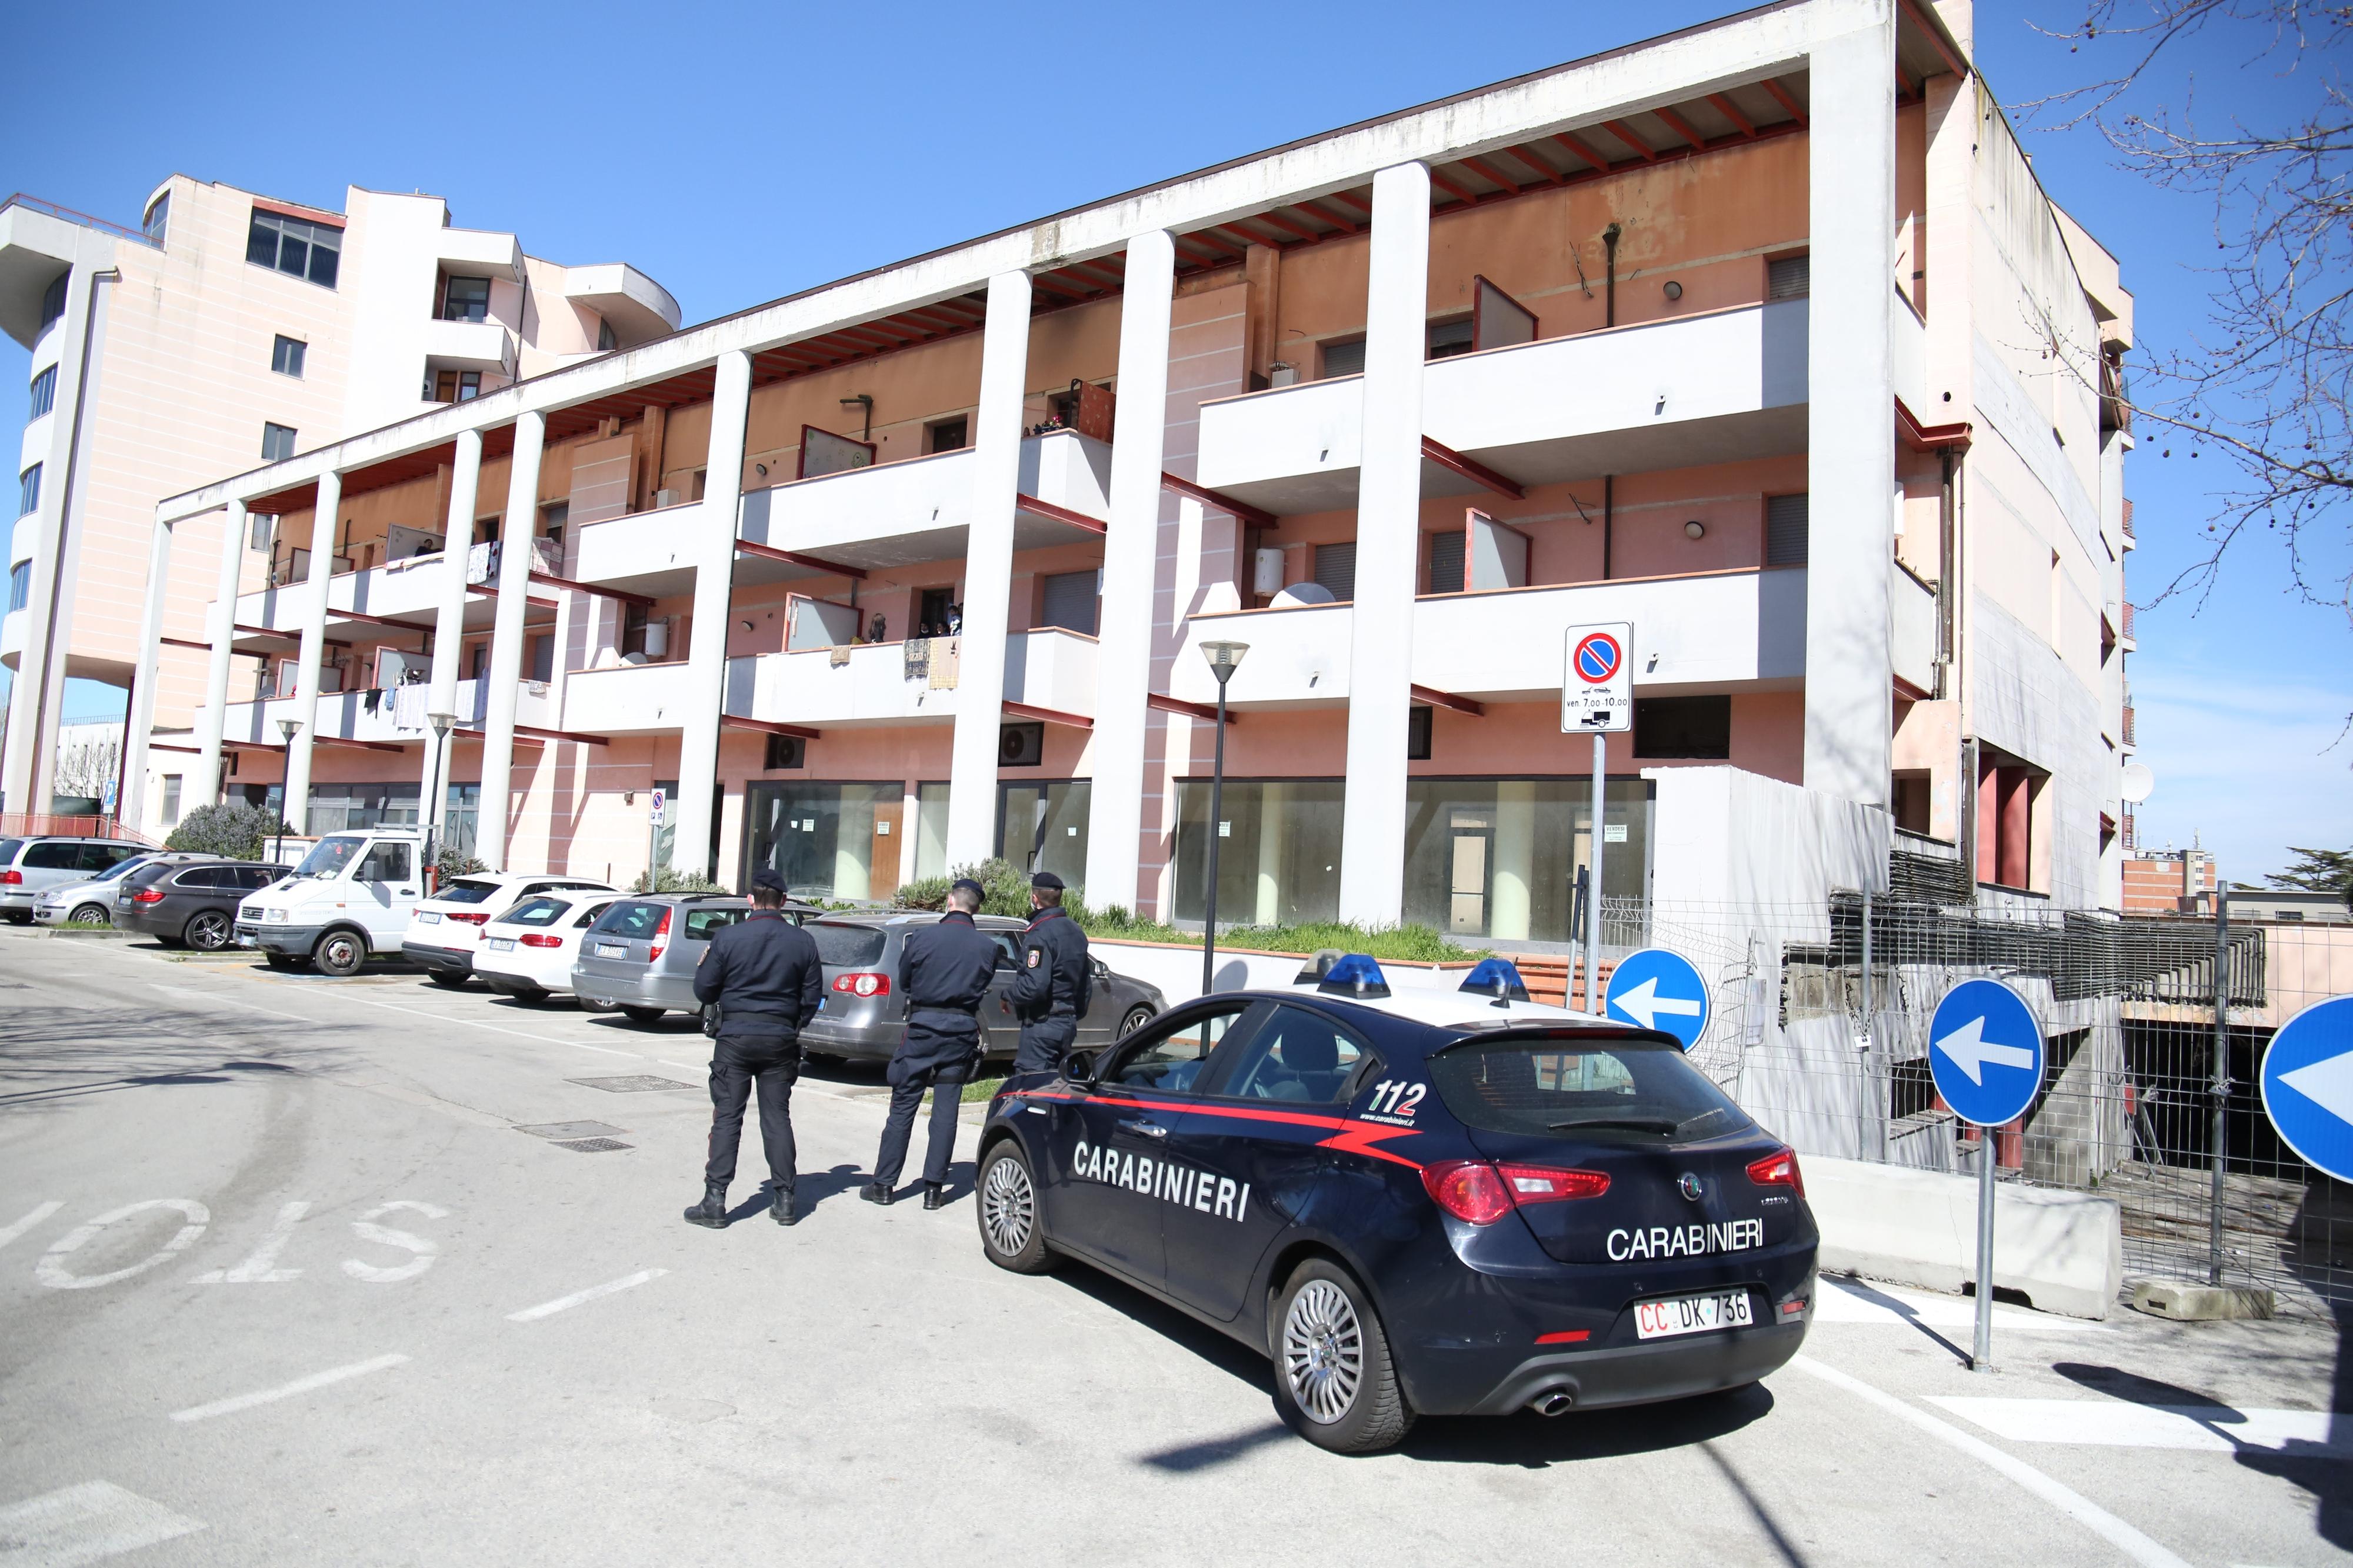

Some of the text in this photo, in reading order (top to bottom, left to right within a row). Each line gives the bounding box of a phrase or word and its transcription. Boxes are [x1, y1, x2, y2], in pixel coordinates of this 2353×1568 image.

[106, 783, 114, 802] P
[1368, 1079, 1427, 1116] 112
[1359, 1113, 1415, 1127] www.carabinieri.it
[1074, 1141, 1250, 1222] CARABINIERI
[0, 1198, 449, 1289] STO
[1607, 1218, 1763, 1261] CARABINIERI
[1641, 1293, 1747, 1333] CC DK 736
